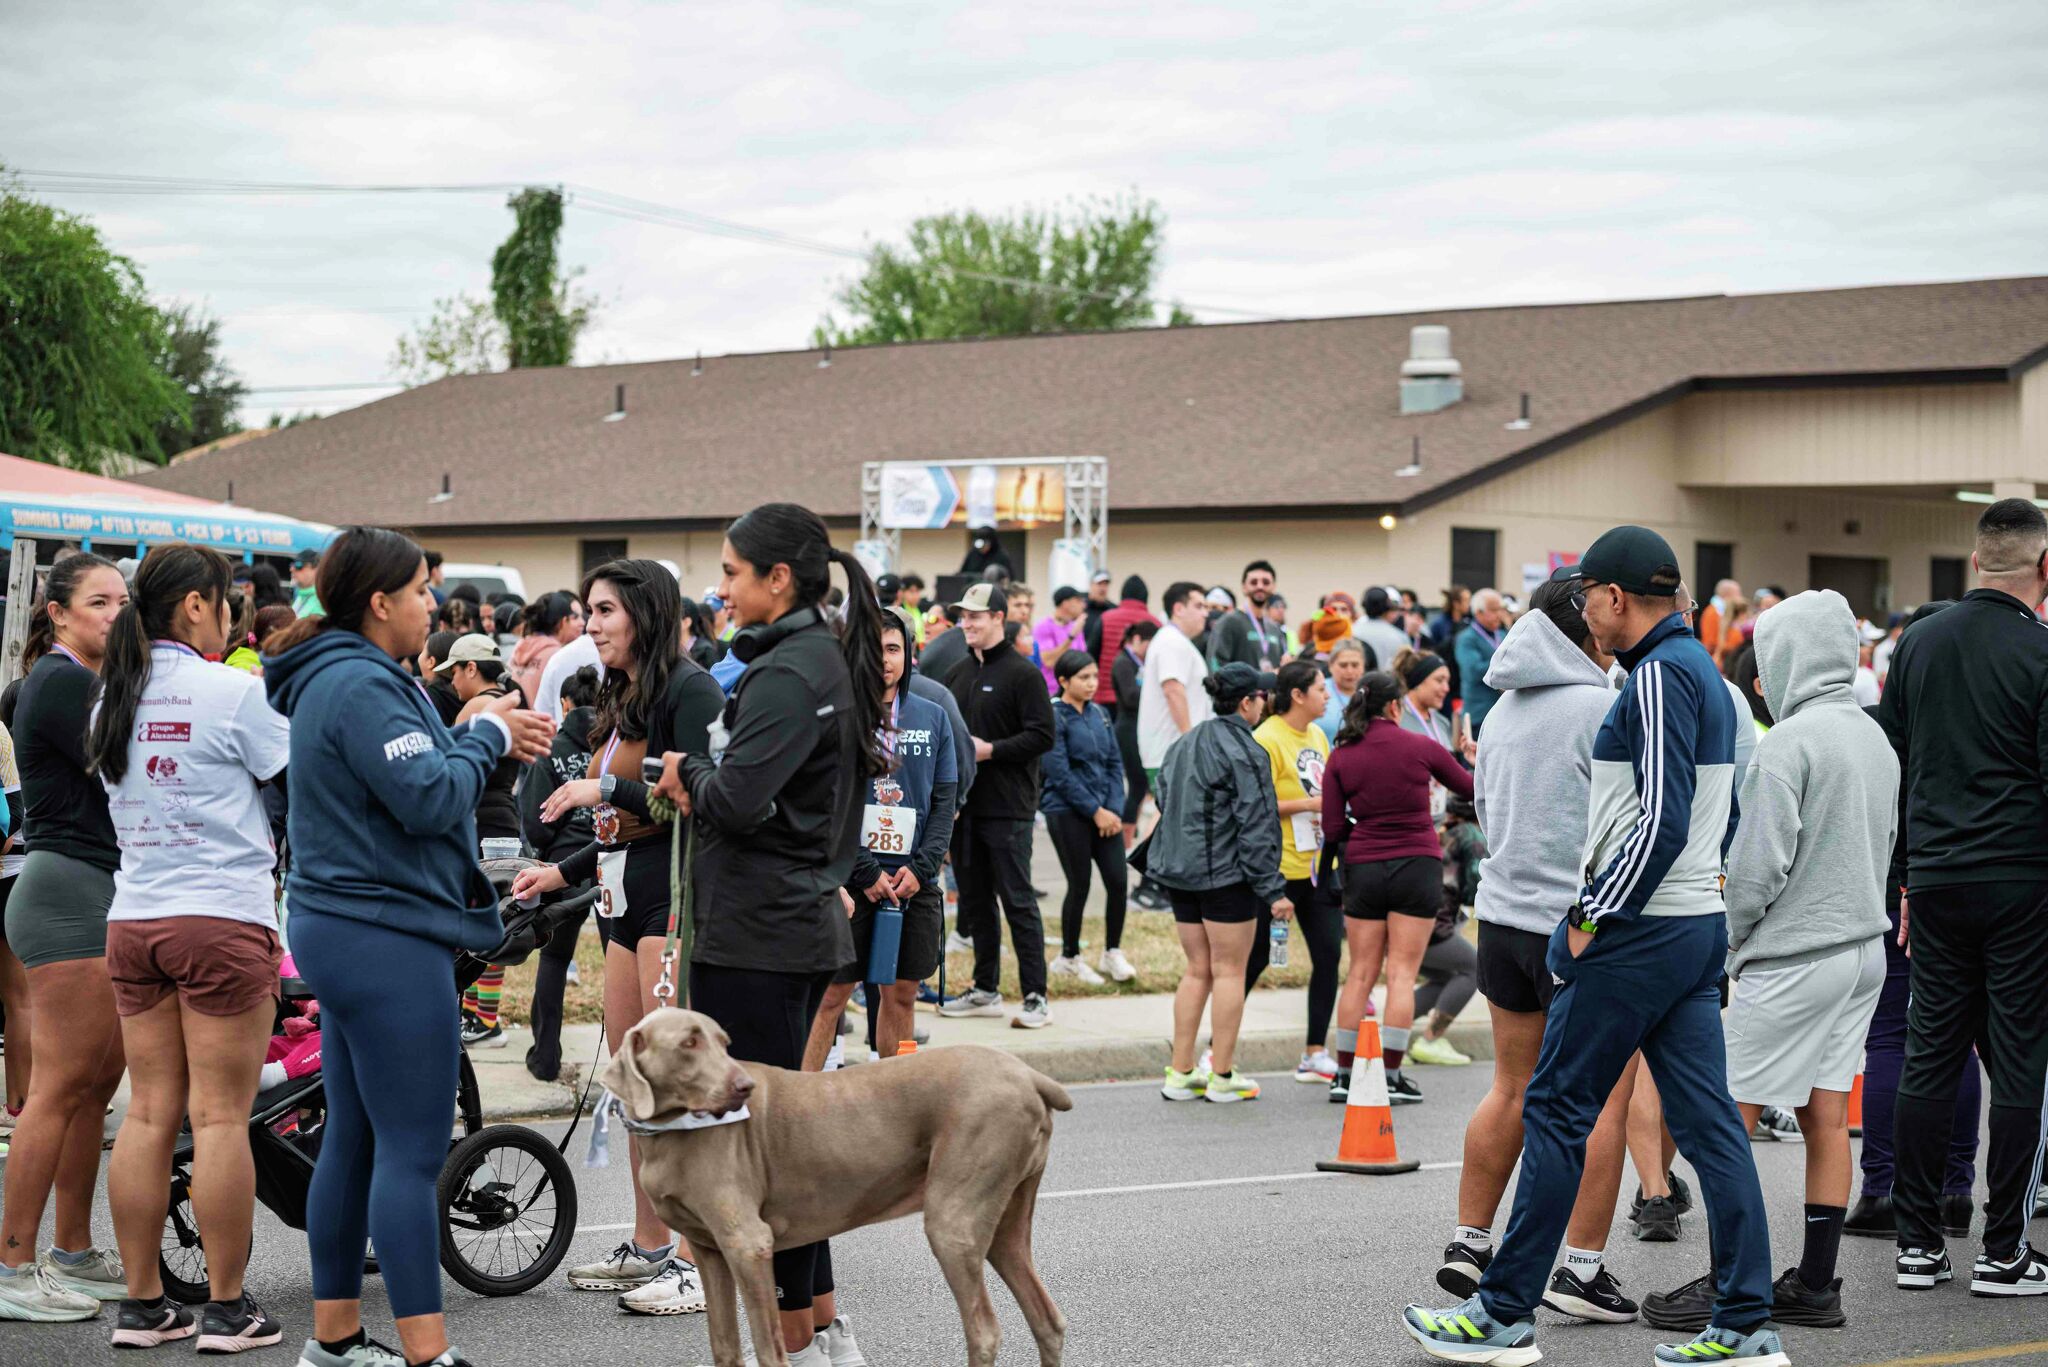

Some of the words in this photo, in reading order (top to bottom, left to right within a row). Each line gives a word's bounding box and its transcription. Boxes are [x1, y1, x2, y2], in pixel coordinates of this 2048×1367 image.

[11, 508, 59, 528] SUMMER
[61, 512, 92, 531] CAMP
[101, 515, 134, 534] AFTER
[134, 518, 175, 537] SCHOOL
[150, 732, 189, 741] Alexander
[151, 724, 175, 733] Grupo
[895, 728, 931, 744] ezer
[867, 832, 903, 852] 283
